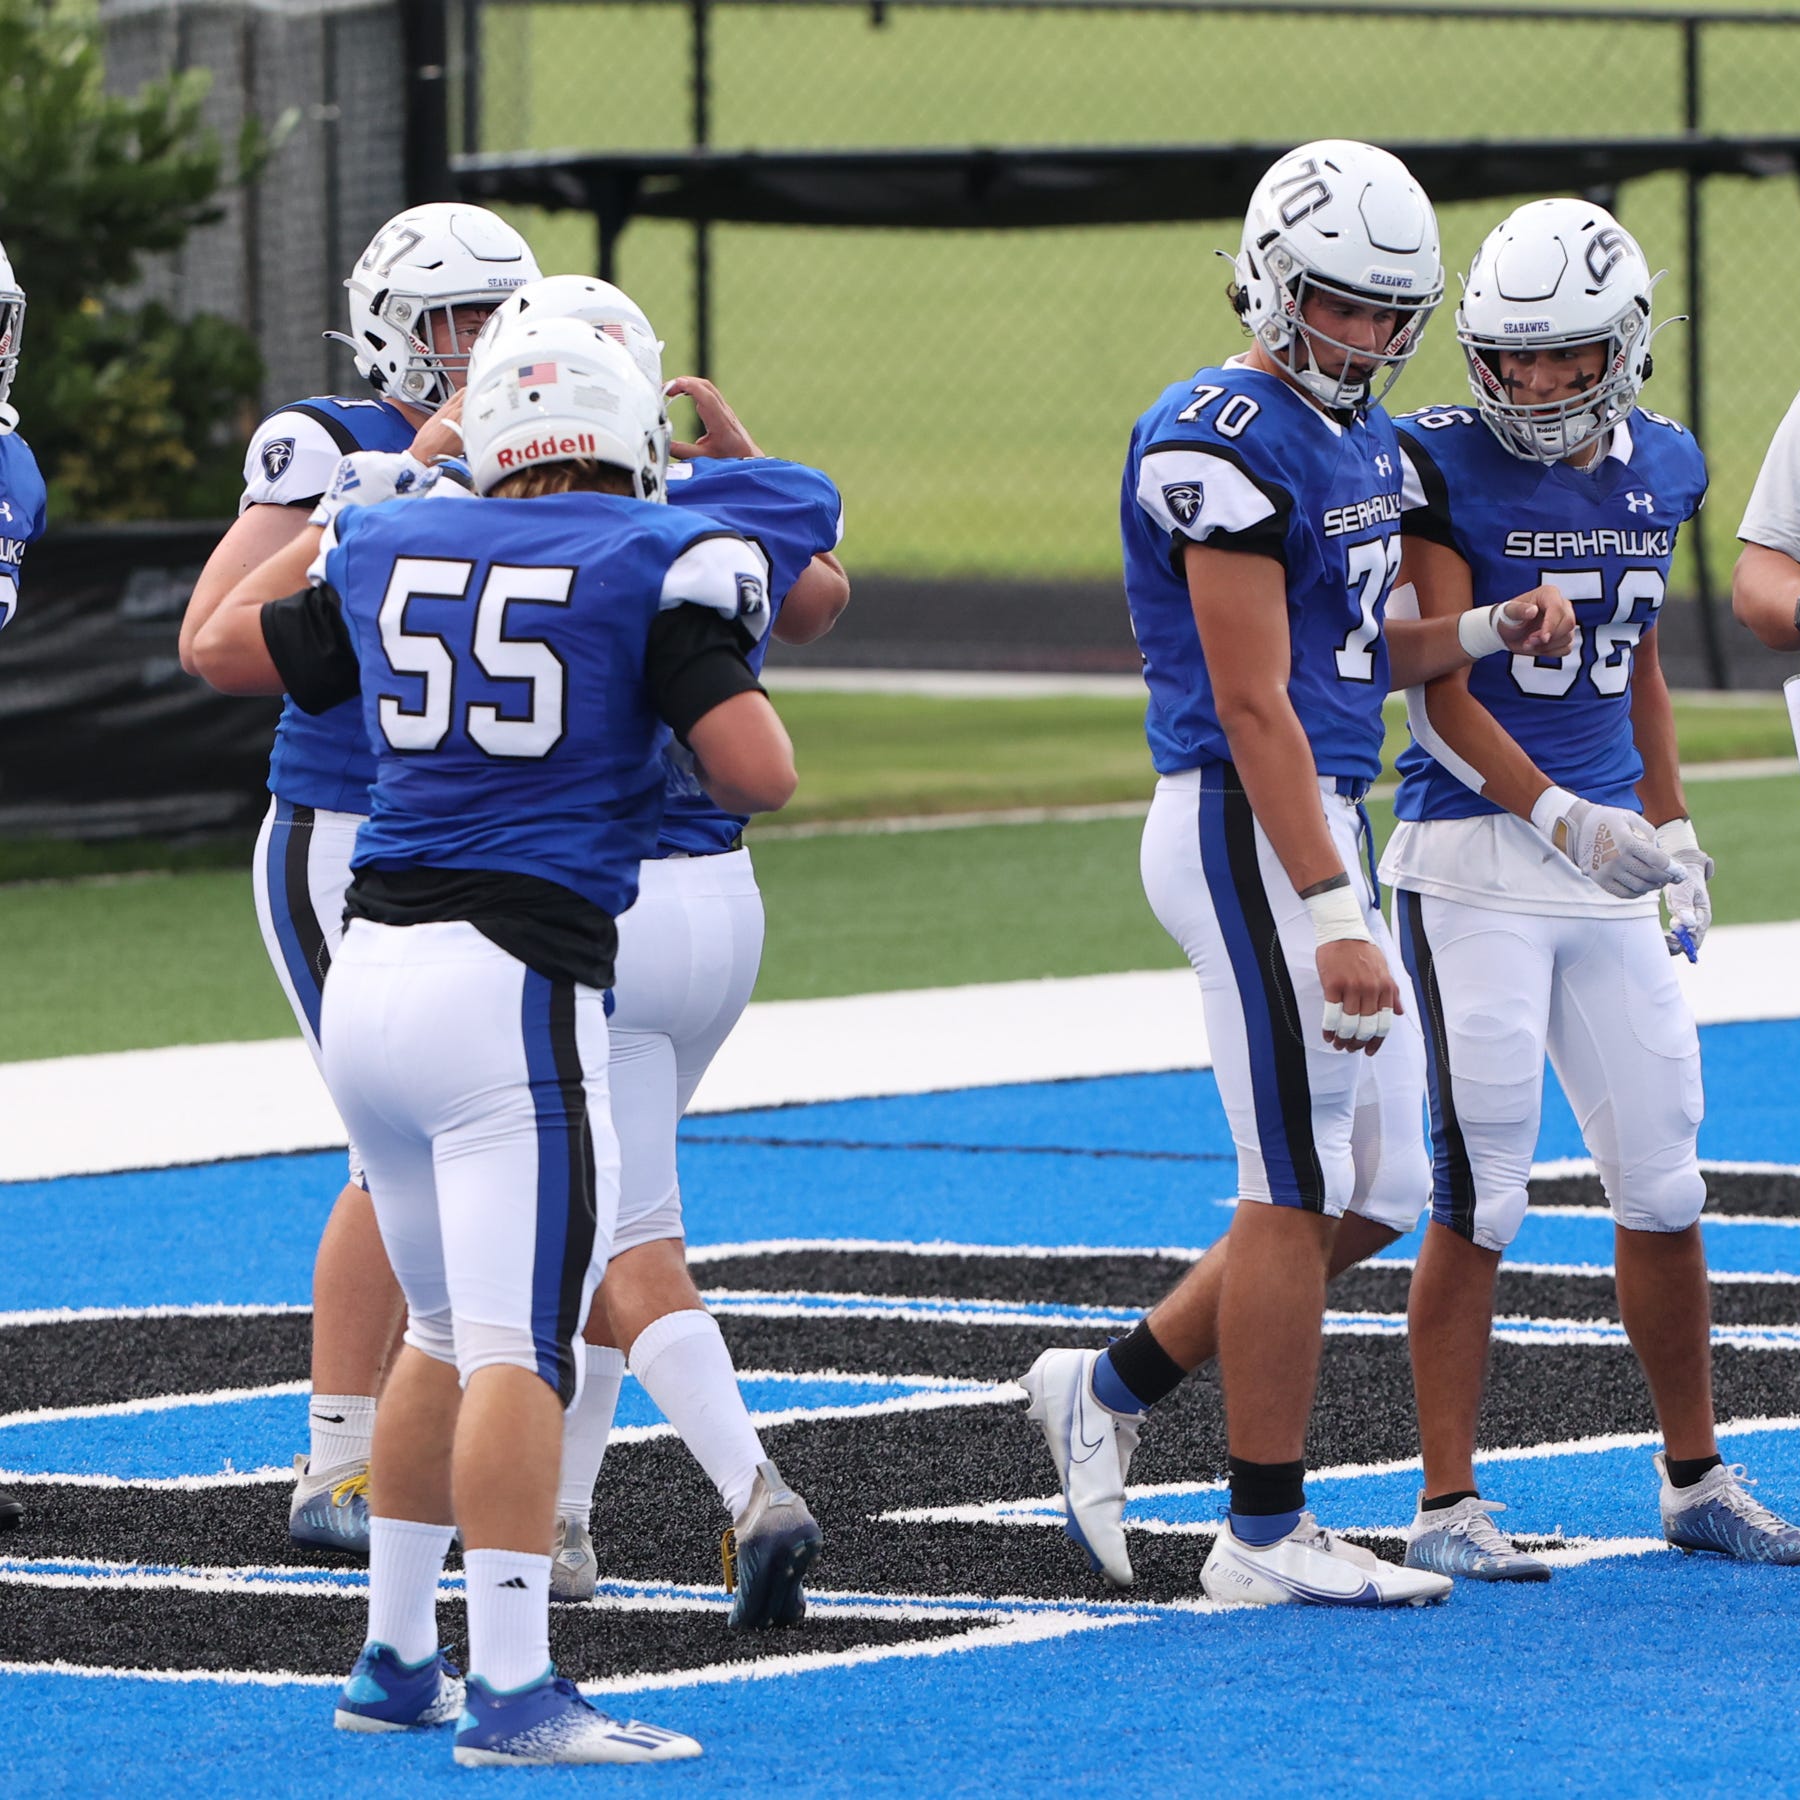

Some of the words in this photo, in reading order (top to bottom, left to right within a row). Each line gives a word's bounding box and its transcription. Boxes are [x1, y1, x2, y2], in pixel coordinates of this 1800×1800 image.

[1370, 273, 1413, 288] SEAHAWKS
[1503, 321, 1550, 334] SEAHAWKS
[1471, 356, 1502, 395] Riddell
[1175, 385, 1262, 441] 70
[1535, 424, 1562, 434] Riddell
[496, 434, 597, 469] Riddell
[1323, 492, 1401, 538] SEAHAW
[1503, 529, 1671, 559] SEAHAWKS
[1507, 566, 1668, 700] 56
[376, 553, 580, 763] 55
[1591, 823, 1607, 872] adidas
